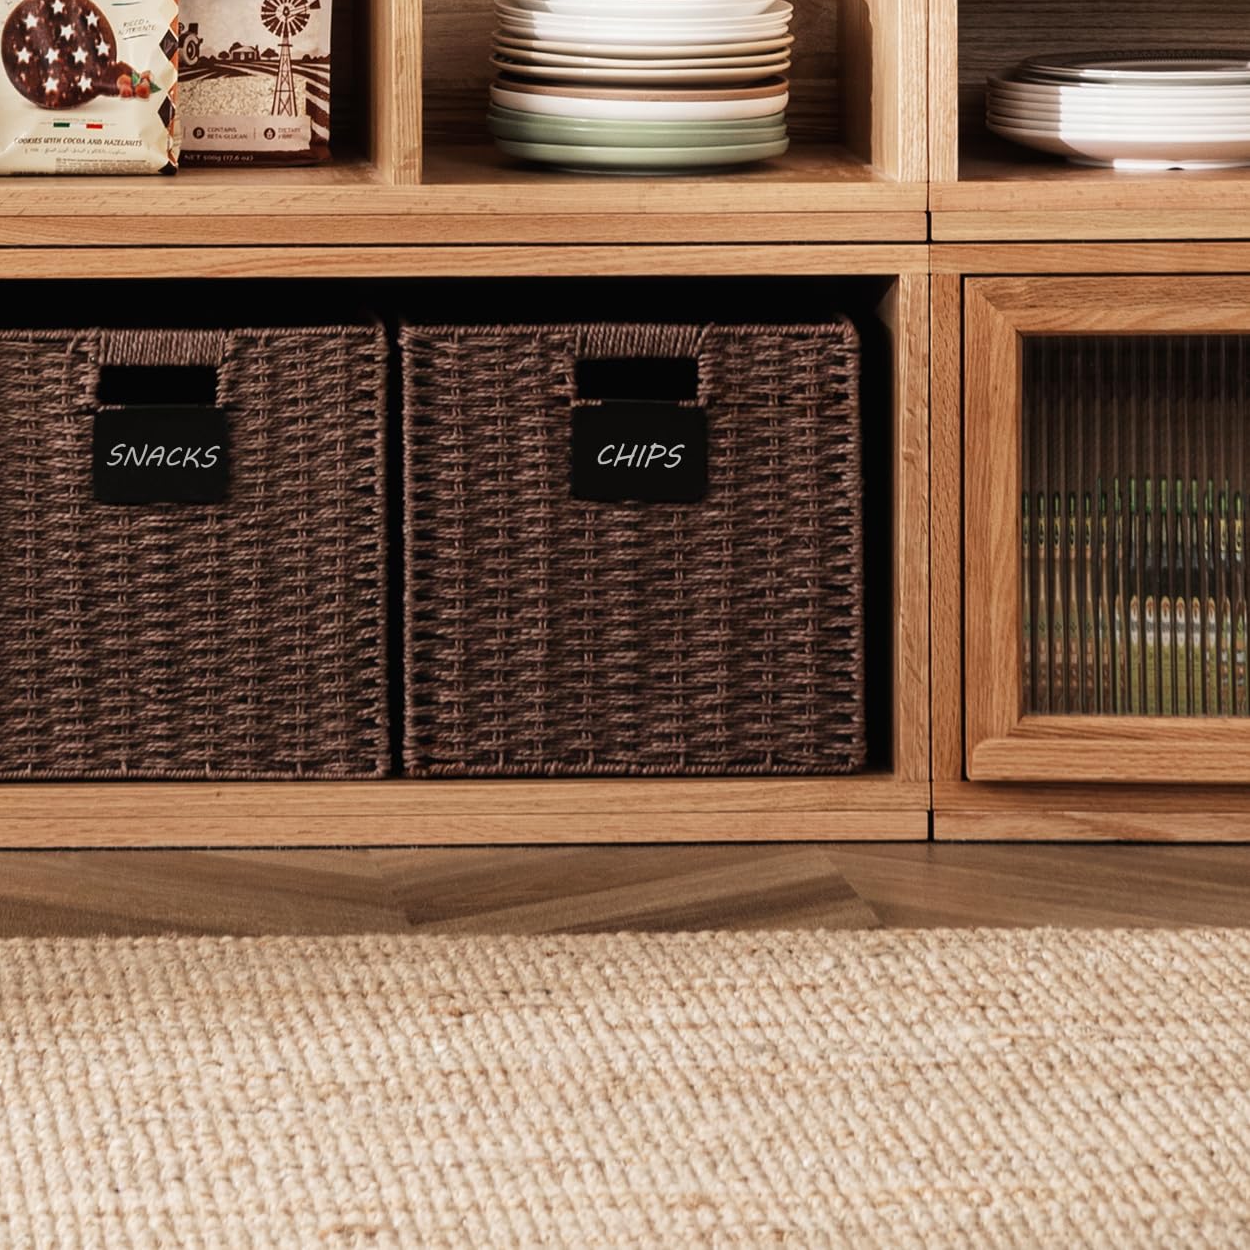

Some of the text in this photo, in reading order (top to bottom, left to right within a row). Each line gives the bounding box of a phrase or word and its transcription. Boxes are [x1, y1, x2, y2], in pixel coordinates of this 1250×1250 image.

[63, 137, 85, 145] COCOA
[106, 443, 221, 469] SNACKS
[597, 442, 686, 469] CHIPS
